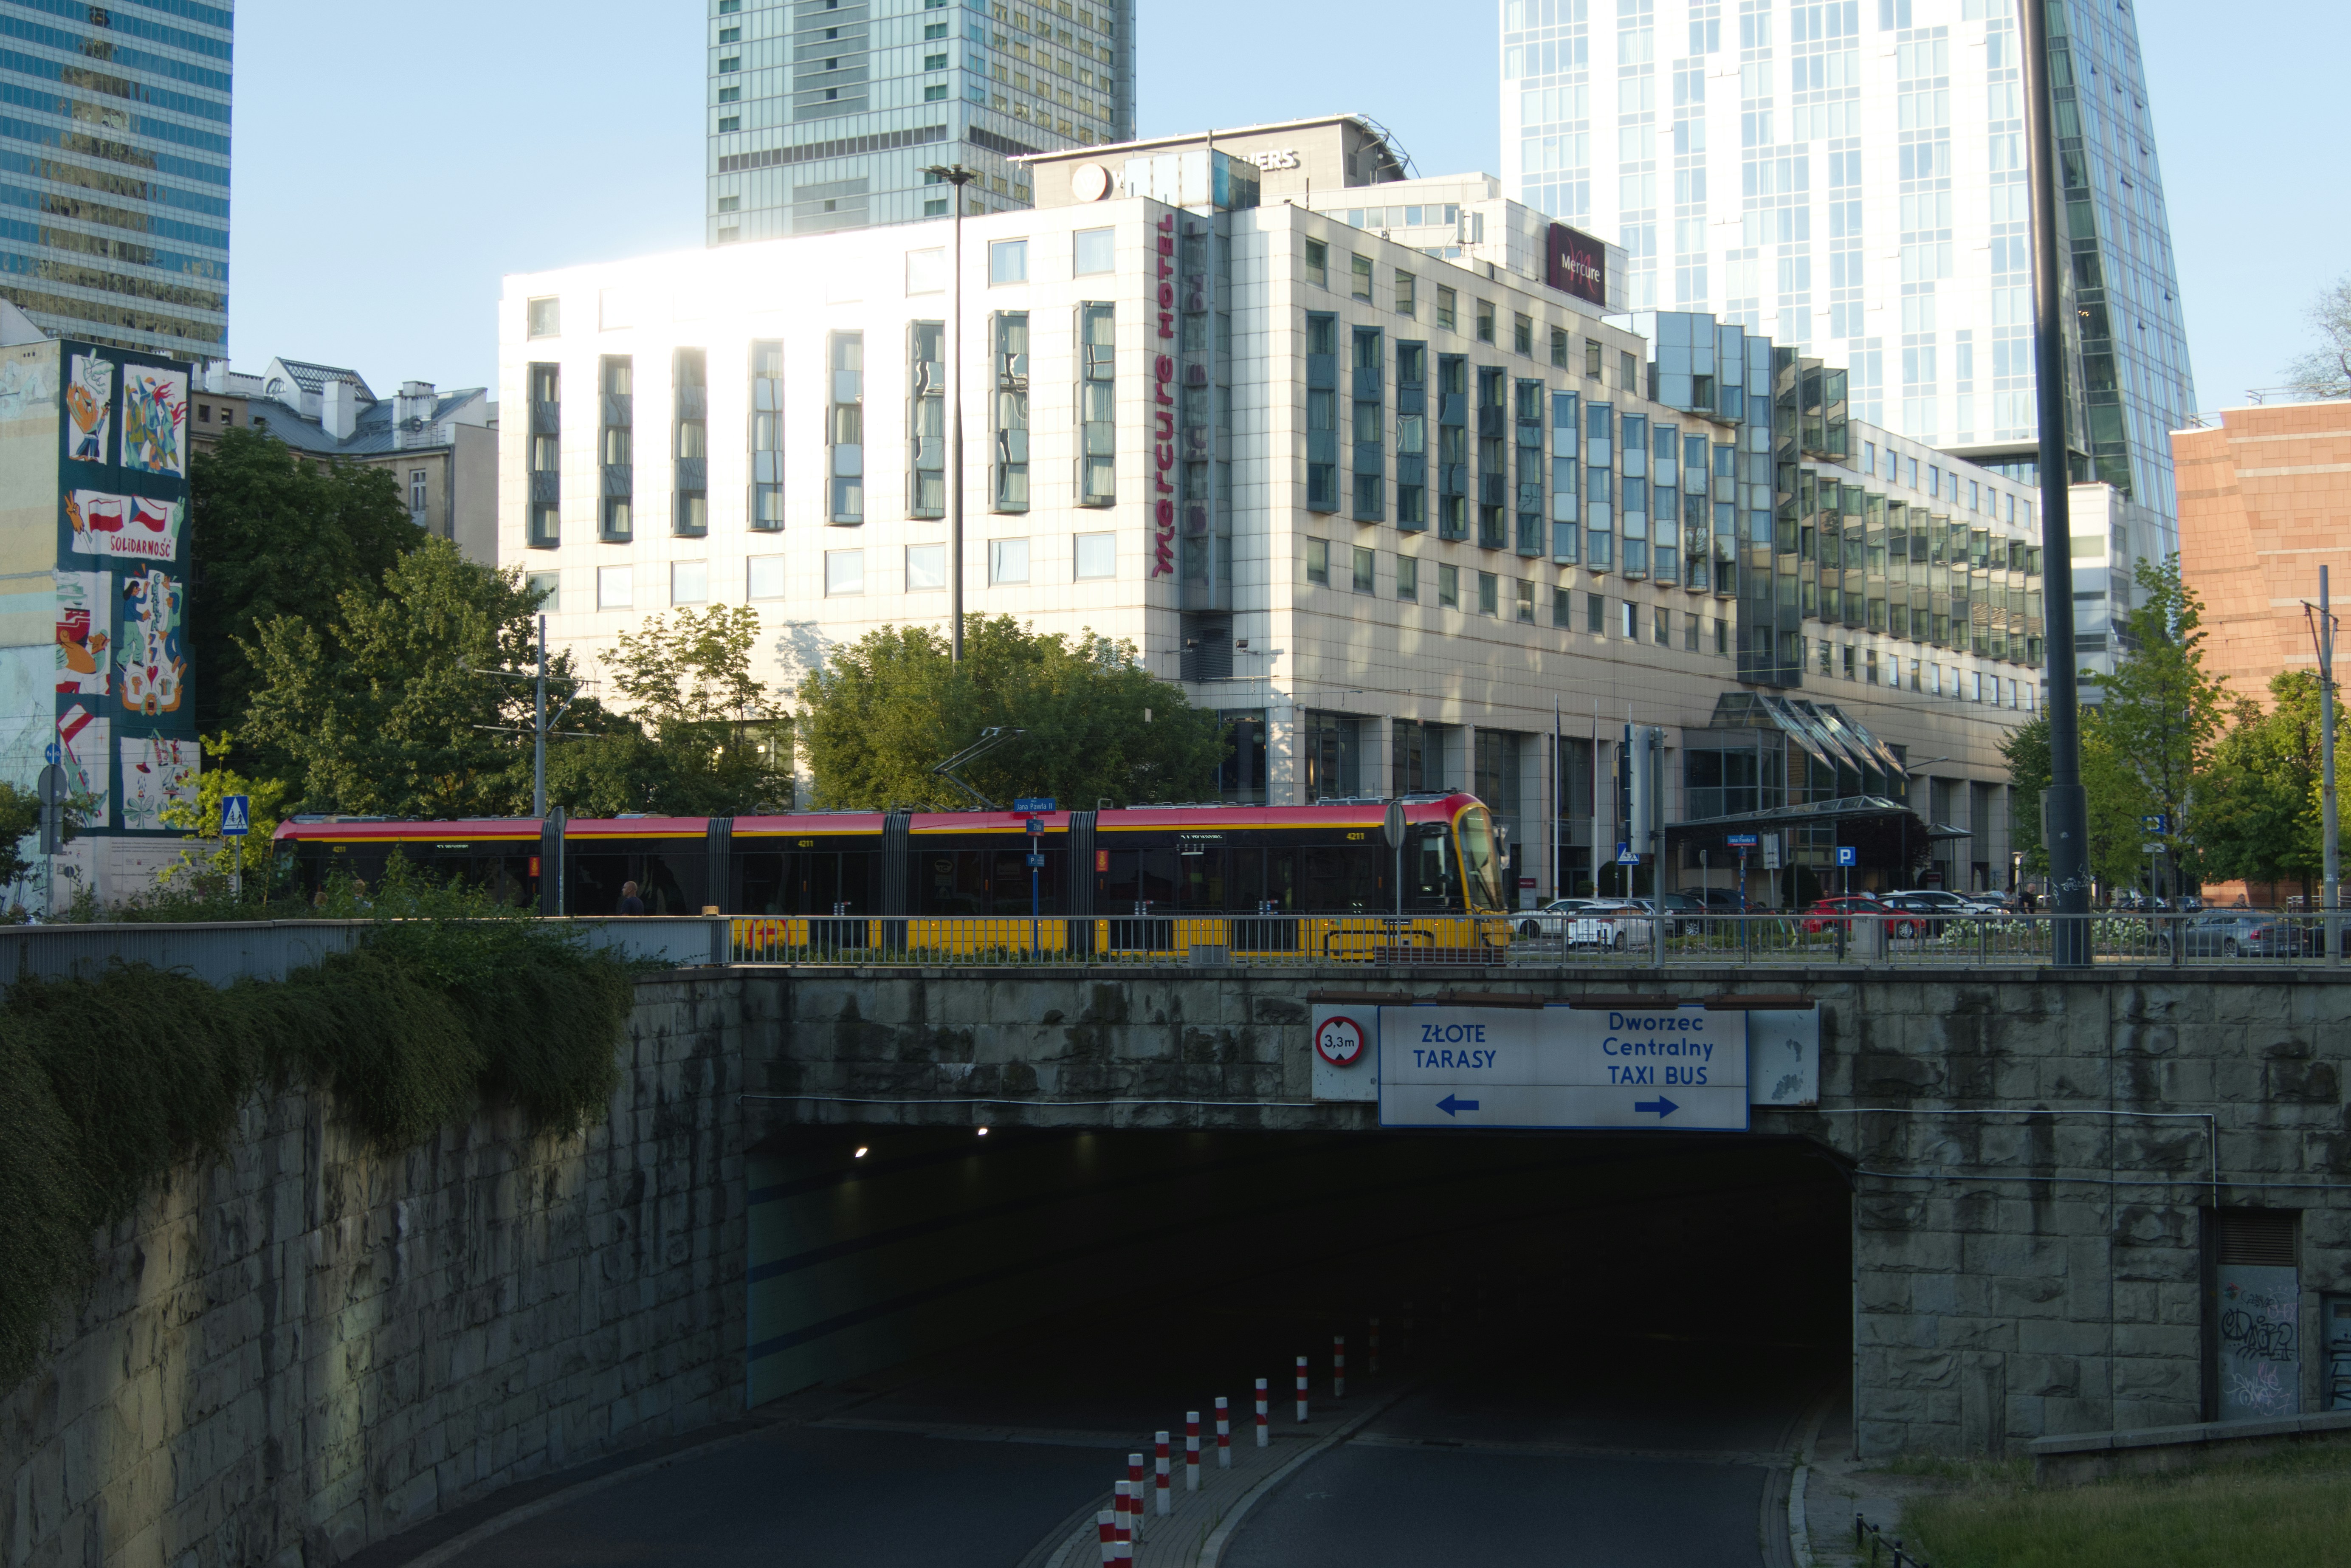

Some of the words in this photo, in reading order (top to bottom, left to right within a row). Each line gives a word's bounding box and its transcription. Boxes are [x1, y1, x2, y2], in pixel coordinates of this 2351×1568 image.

[1158, 214, 1174, 338] HOTEL
[1562, 253, 1600, 282] Mercure
[1840, 849, 1851, 864] P
[1609, 1012, 1704, 1031] Dworzec
[1421, 1024, 1486, 1043] ZŁOTE
[1413, 1049, 1497, 1069] TARASY
[1602, 1037, 1714, 1062] Centralny
[1607, 1065, 1654, 1085] TAXI
[1665, 1066, 1708, 1086] BUS
